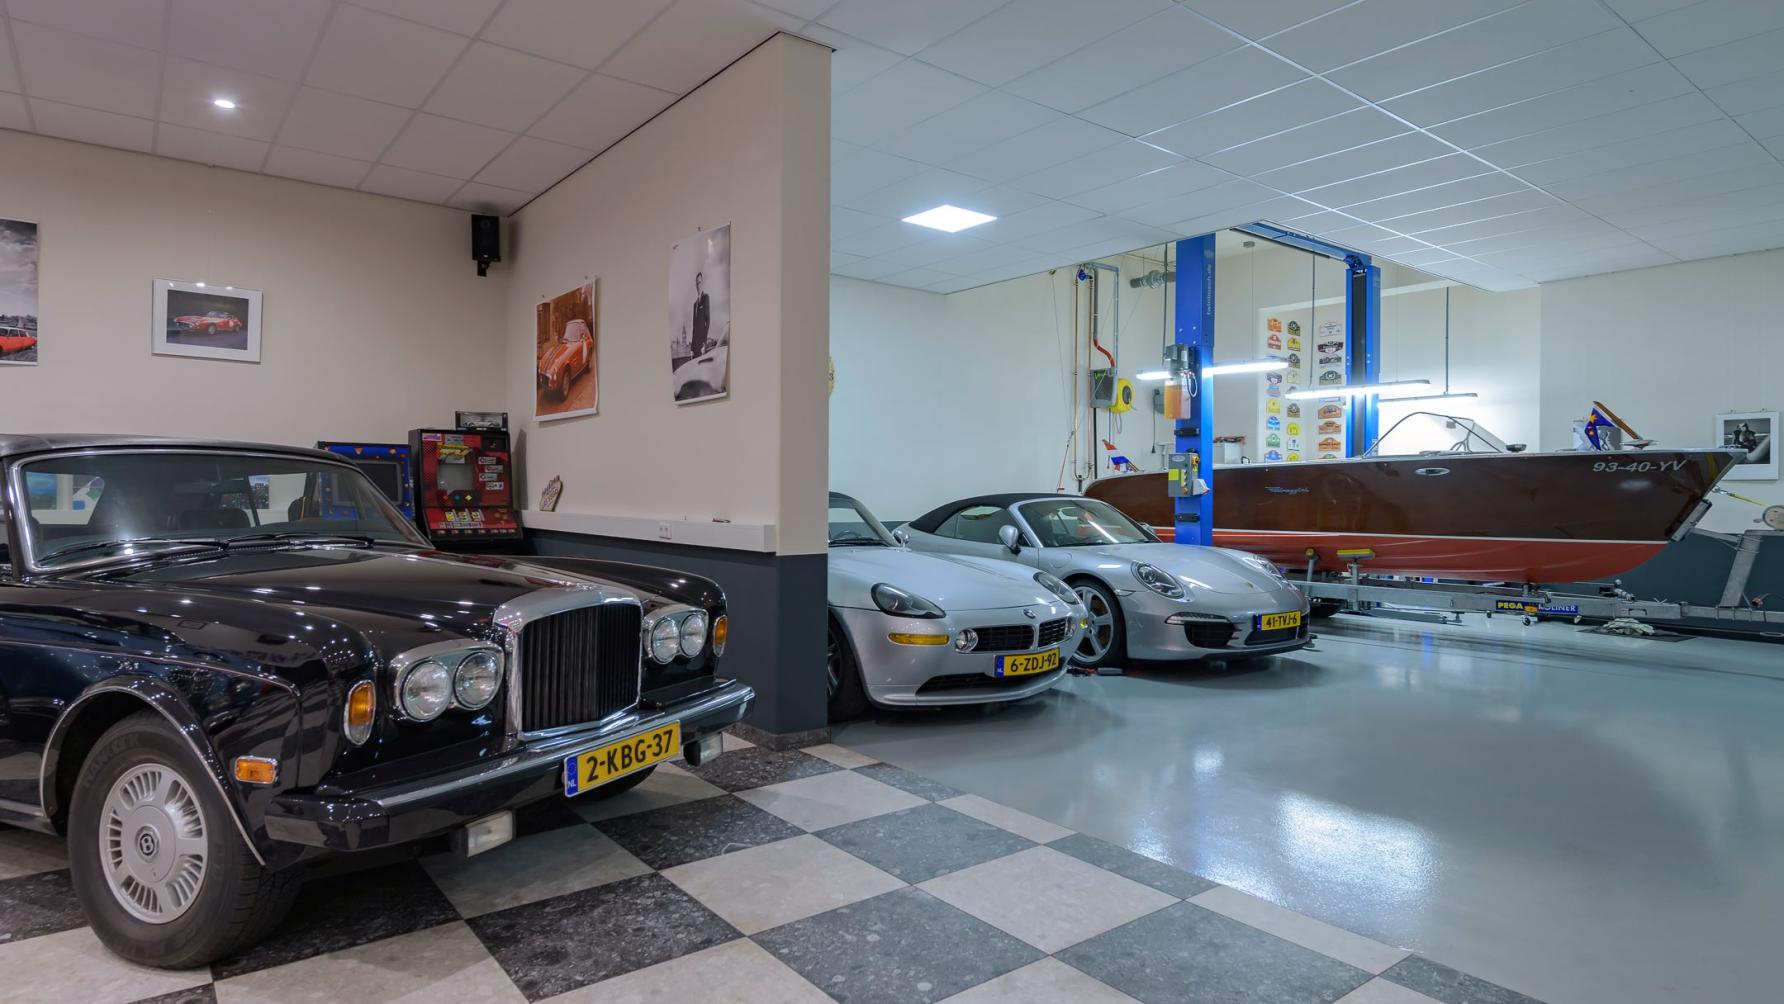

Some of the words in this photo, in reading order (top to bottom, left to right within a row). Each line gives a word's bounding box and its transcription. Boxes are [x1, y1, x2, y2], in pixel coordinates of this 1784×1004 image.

[1592, 459, 1688, 472] 93-40-YV
[1266, 613, 1298, 628] 41-TVJ-6
[1010, 652, 1057, 672] 6-ZDJ-92
[567, 779, 577, 788] NL
[586, 729, 673, 783] 2-KBG-37
